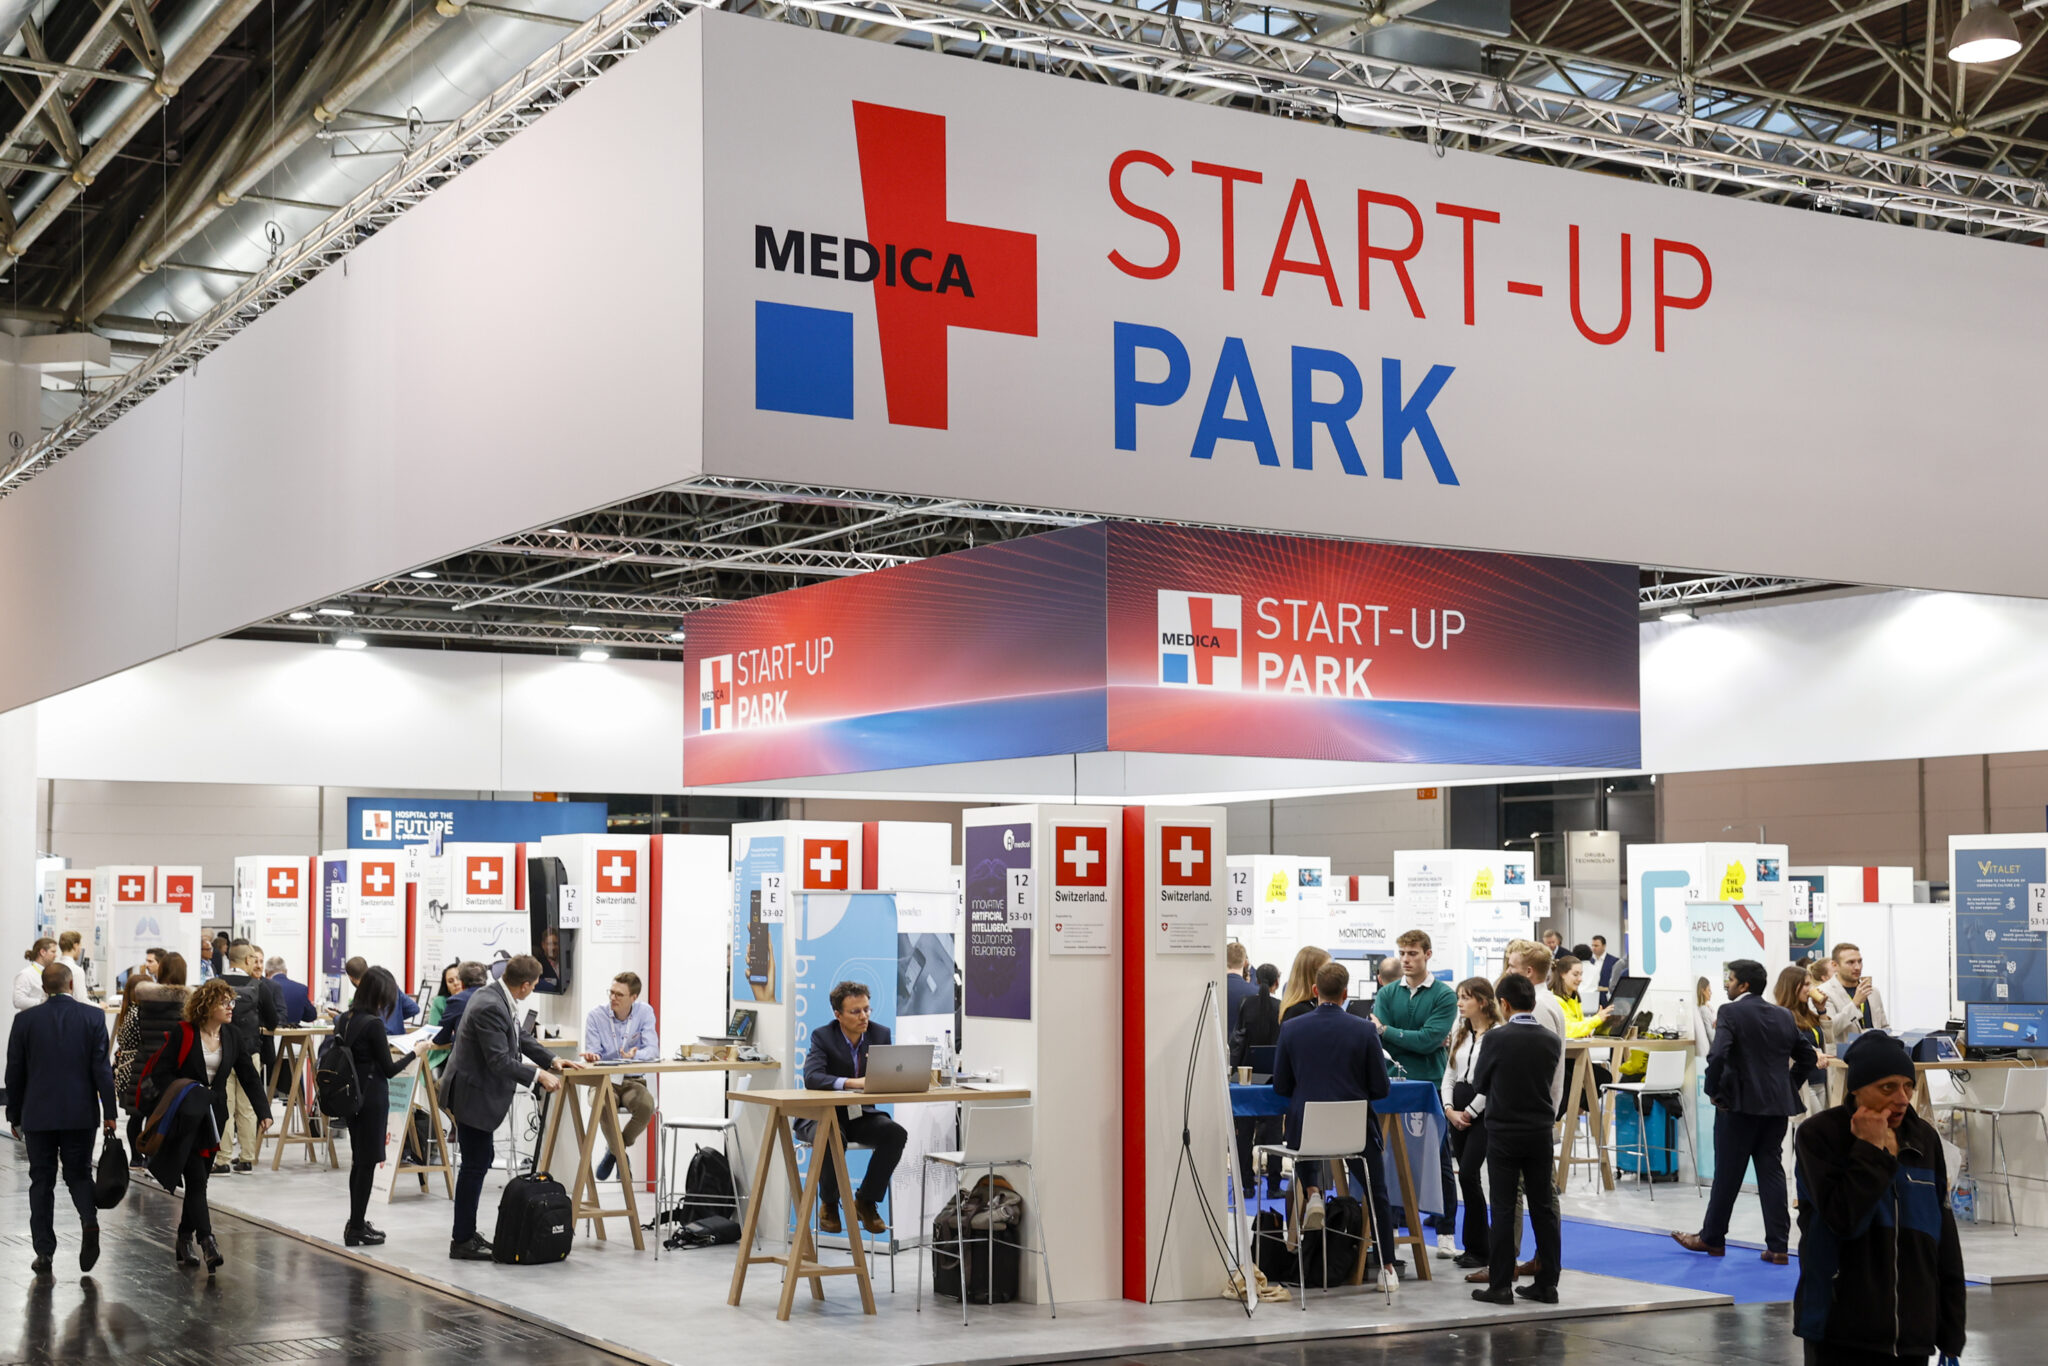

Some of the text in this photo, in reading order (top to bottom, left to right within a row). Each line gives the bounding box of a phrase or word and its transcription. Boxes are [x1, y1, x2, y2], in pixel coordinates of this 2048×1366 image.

[1107, 149, 1713, 353] START-UP
[755, 224, 975, 298] MEDICA
[1113, 321, 1461, 487] PARK
[1256, 597, 1466, 650] START-UP
[1162, 632, 1221, 649] MEDICA
[738, 636, 834, 687] START-UP
[1258, 652, 1374, 699] PARK
[702, 689, 724, 702] MEDICA
[738, 690, 788, 728] PARK
[395, 810, 453, 820] HOSPITAL OF THE
[395, 820, 454, 835] FUTURE
[409, 849, 417, 857] 12
[411, 860, 415, 868] E
[768, 878, 780, 888] 12
[1014, 874, 1029, 887] 12
[1233, 872, 1246, 884] 12
[336, 886, 345, 894] 12
[565, 889, 576, 899] 12
[1333, 889, 1342, 897] 12
[1689, 890, 1699, 898] 12
[1793, 885, 1803, 893] 12
[2035, 888, 2046, 898] 12
[595, 896, 637, 905] Switzerland.
[770, 893, 776, 903] E
[1018, 893, 1024, 904] E
[1055, 890, 1107, 902] Switzerland.
[1161, 890, 1212, 902] Switzerland.
[1236, 890, 1243, 902] E
[568, 902, 573, 911] E
[1795, 897, 1800, 906] E
[734, 866, 742, 956] biospectal
[1227, 907, 1252, 917] 53-09
[2037, 902, 2043, 912] E
[762, 909, 784, 918] 53-02
[971, 912, 1003, 920] ARTIFICIAL
[1009, 912, 1032, 921] 53-01
[561, 916, 580, 924] 53-03
[1692, 921, 1724, 931] APELVO
[1339, 929, 1386, 938] MONITORING
[971, 934, 1013, 944] SOLUTION FOR
[971, 946, 1016, 956] NEUROIMAGING
